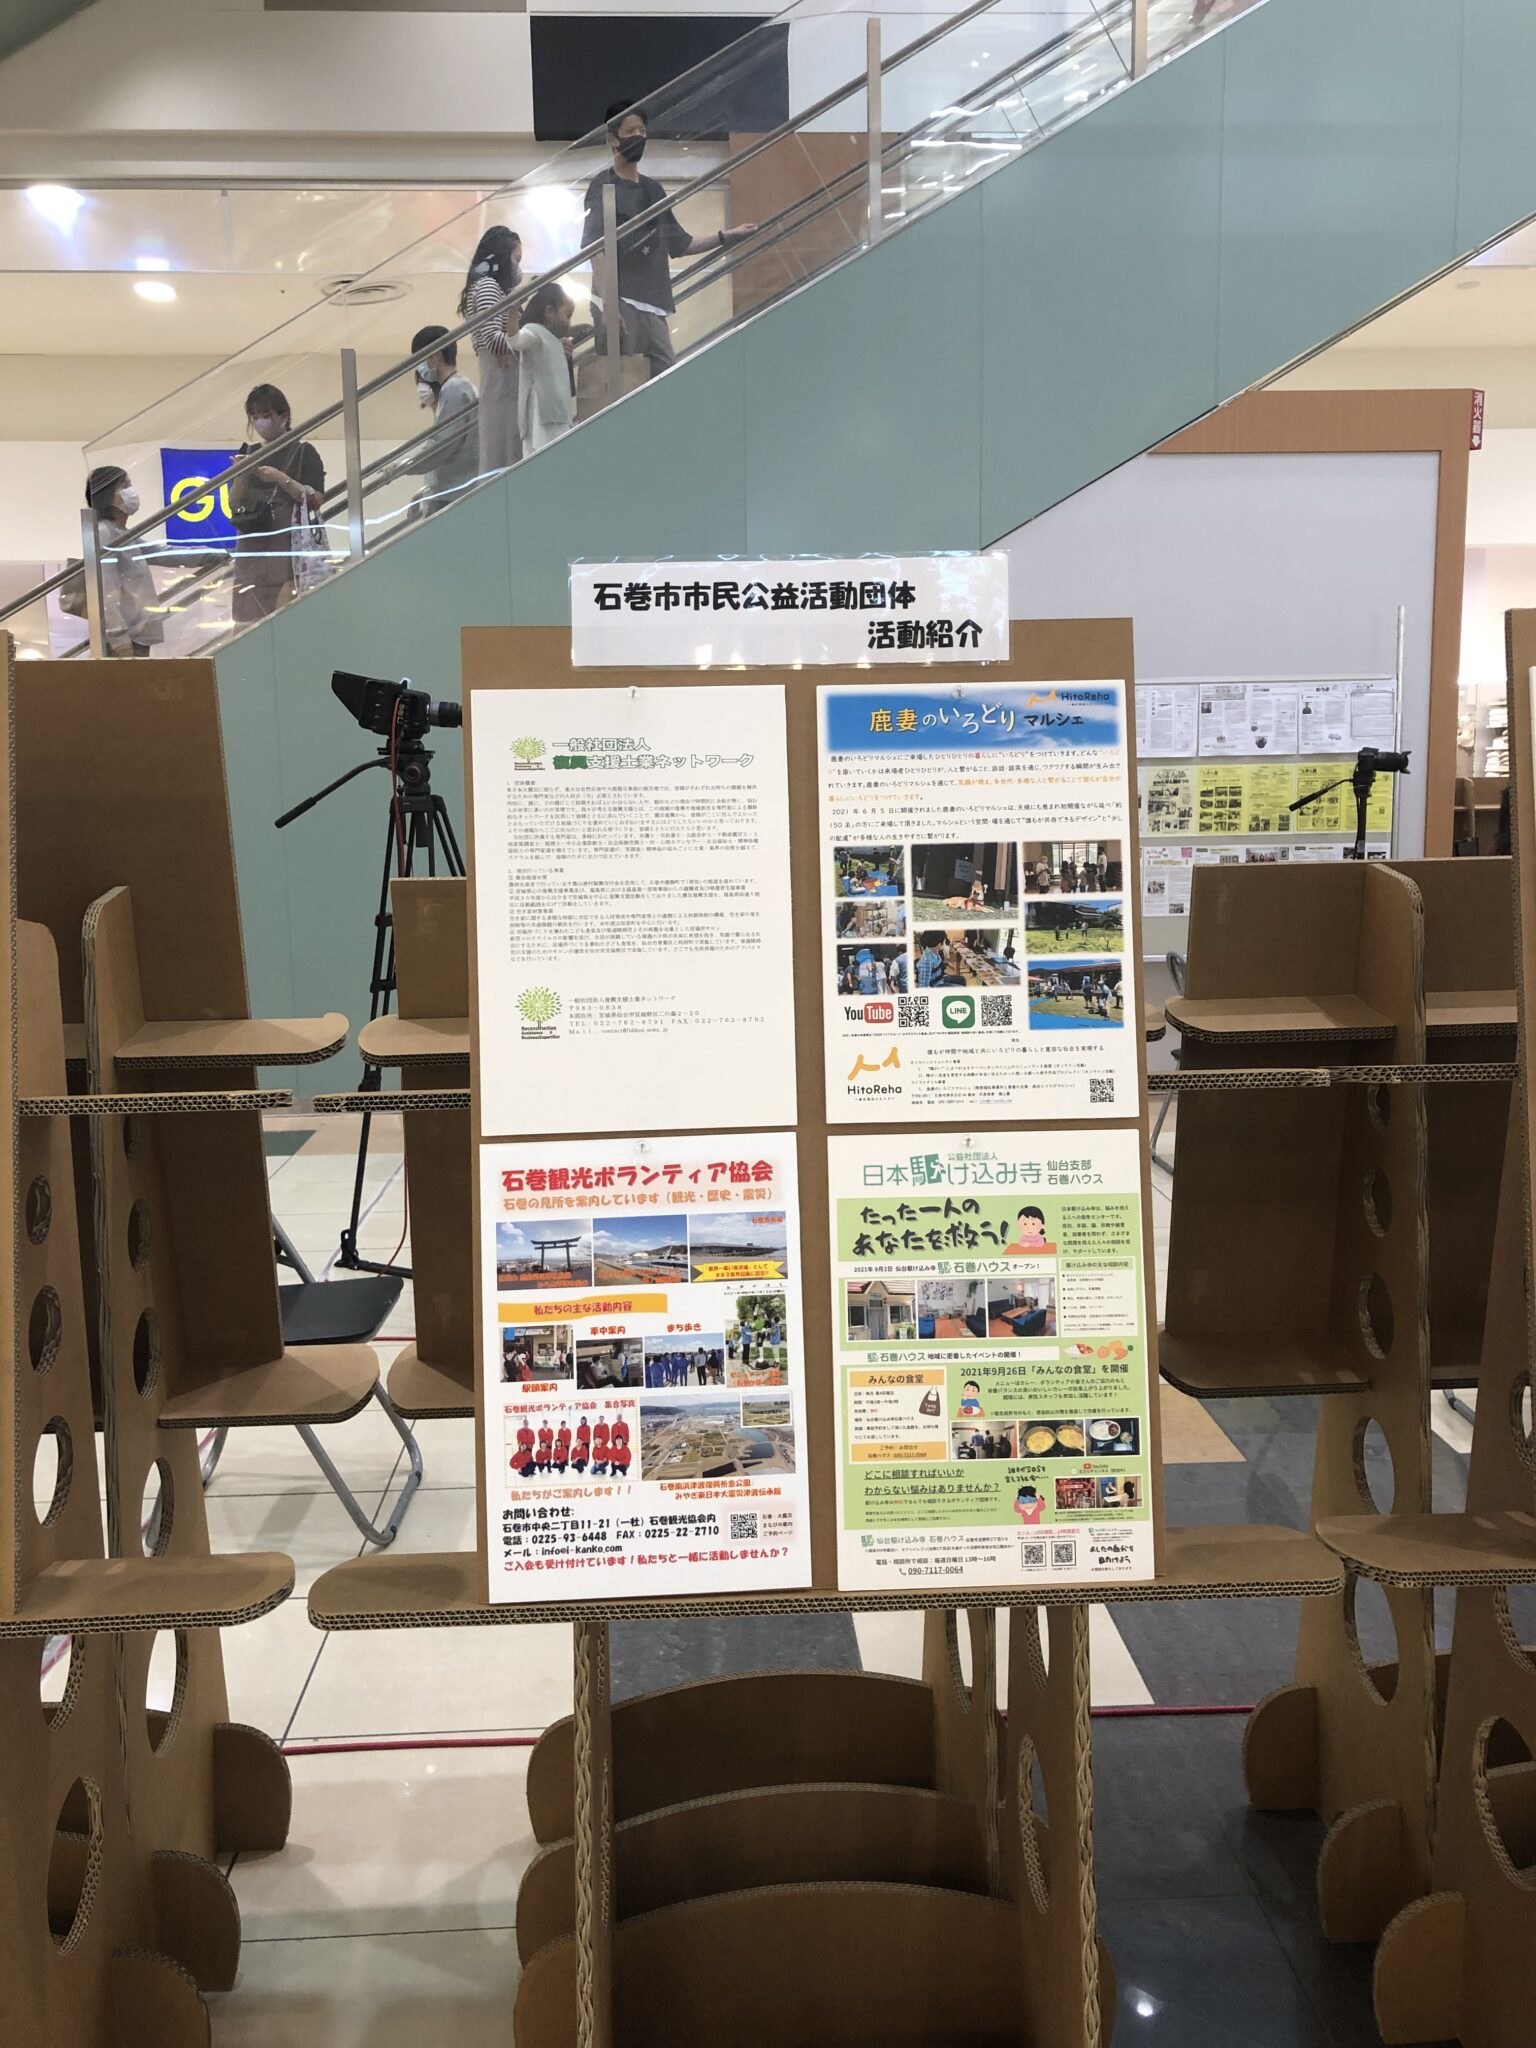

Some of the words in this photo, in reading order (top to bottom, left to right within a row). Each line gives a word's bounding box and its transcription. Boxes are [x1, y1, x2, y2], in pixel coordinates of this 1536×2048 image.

[1473, 391, 1484, 434] 消火器
[593, 581, 917, 612] 石巻市市民公益活動団体
[867, 619, 984, 650] 活動紹介
[1061, 692, 1110, 701] HitoReha
[552, 737, 651, 753] 一般社団法人
[844, 1002, 894, 1023] YouTube
[949, 1007, 967, 1015] LINE
[847, 1084, 902, 1094] HitoReha
[947, 1151, 998, 1161] 公益社団法人
[1047, 1159, 1092, 1171] 仙台支部
[502, 1160, 774, 1192] 石巻観光ボランティア協会
[1047, 1173, 1104, 1185] 石巻ハウス
[860, 1197, 980, 1226] たった一人の
[534, 1301, 632, 1316] 私たちの主な活動内容
[590, 1325, 626, 1336] 車中案内
[666, 1323, 702, 1333] まち歩き
[868, 1374, 924, 1384] みんなの食堂
[504, 1402, 597, 1414] 石巻観光ボランティア協会
[864, 1467, 965, 1480] どこに相談すればいいか
[511, 1485, 632, 1501] 私たちがご案内します！！
[864, 1482, 1001, 1496] わからない悩みはありませんか？
[908, 1566, 964, 1575] 090-7117-0064
